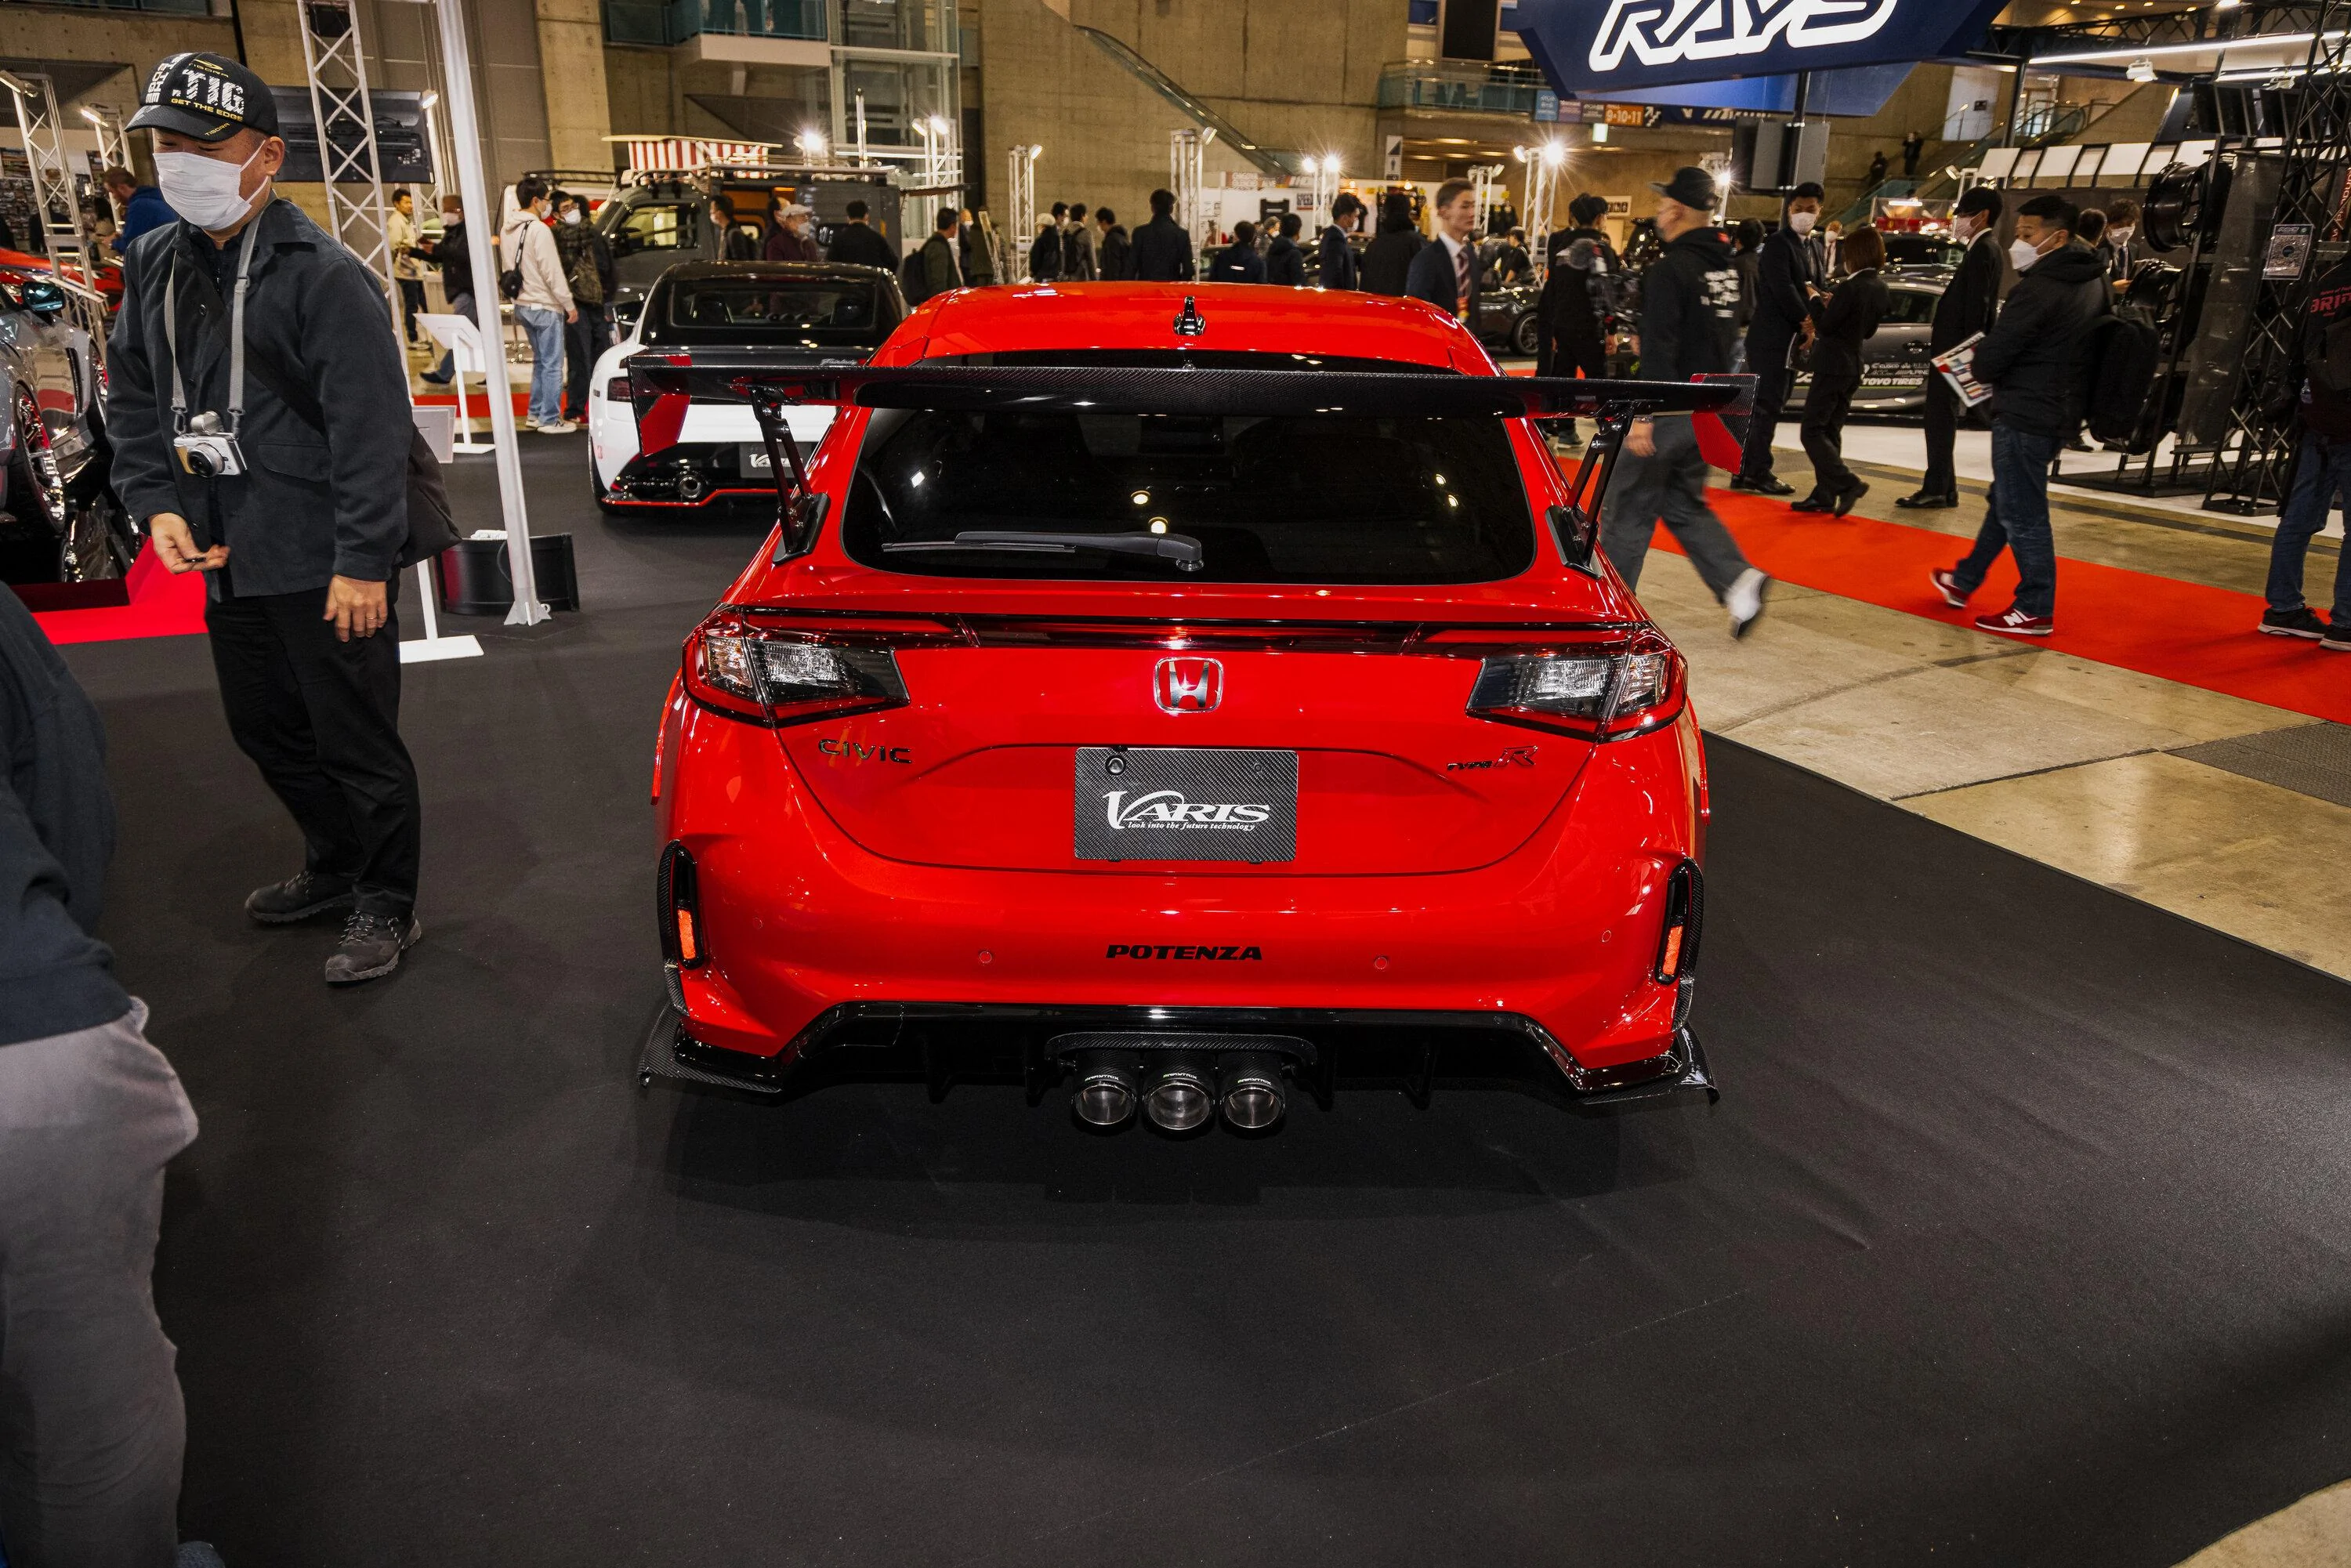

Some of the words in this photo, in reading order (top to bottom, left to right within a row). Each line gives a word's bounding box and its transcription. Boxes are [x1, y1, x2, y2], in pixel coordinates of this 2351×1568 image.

[1589, 0, 1898, 71] RAYS
[194, 103, 214, 112] THE
[216, 109, 245, 122] EDGE
[1862, 377, 1892, 386] TOYO
[1892, 377, 1925, 386] TIRES
[817, 738, 912, 764] CIVIC
[1446, 760, 1494, 771] TYPE
[1493, 744, 1539, 768] R
[1102, 790, 1270, 830] VARIS
[1180, 821, 1208, 831] future
[1210, 822, 1256, 832] technology
[1105, 943, 1263, 961] POTENZA
